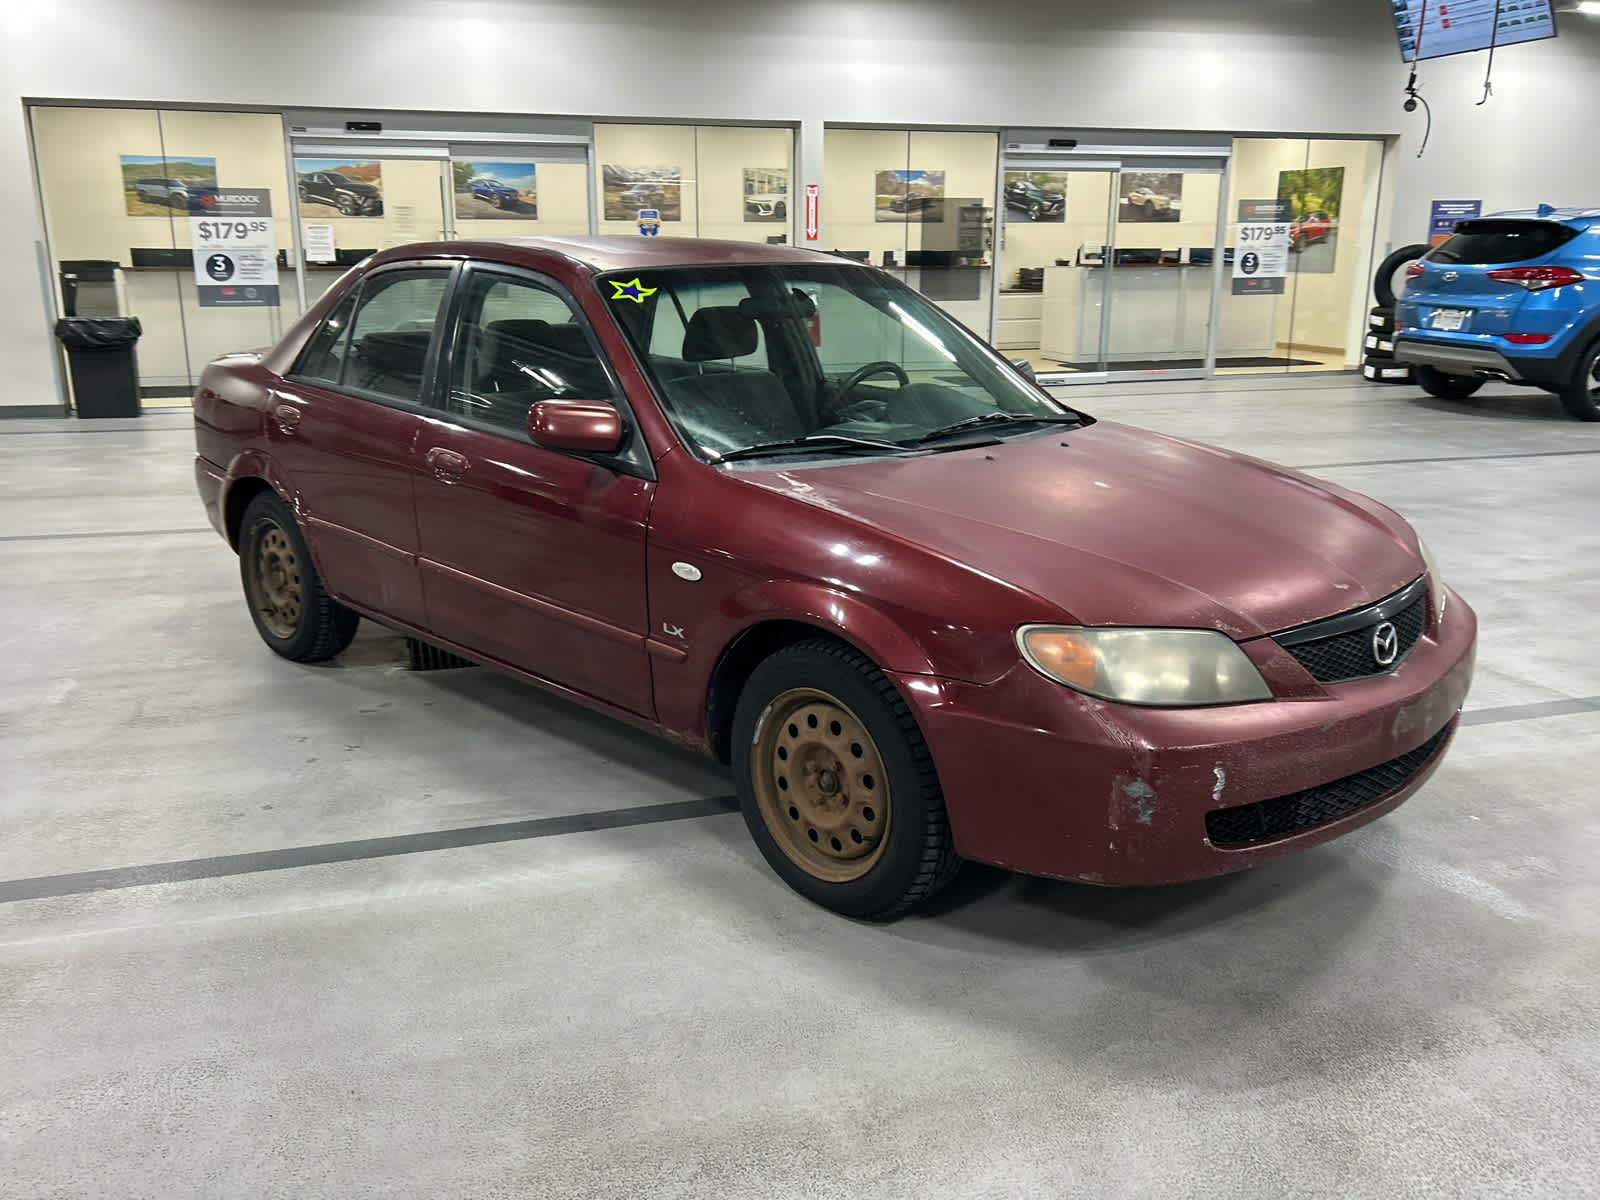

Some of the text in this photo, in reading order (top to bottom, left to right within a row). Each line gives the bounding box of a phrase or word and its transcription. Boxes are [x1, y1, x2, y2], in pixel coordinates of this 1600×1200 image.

[198, 221, 267, 241] $179.95
[213, 256, 226, 271] 3
[1246, 254, 1255, 266] 3
[663, 622, 685, 639] LX
